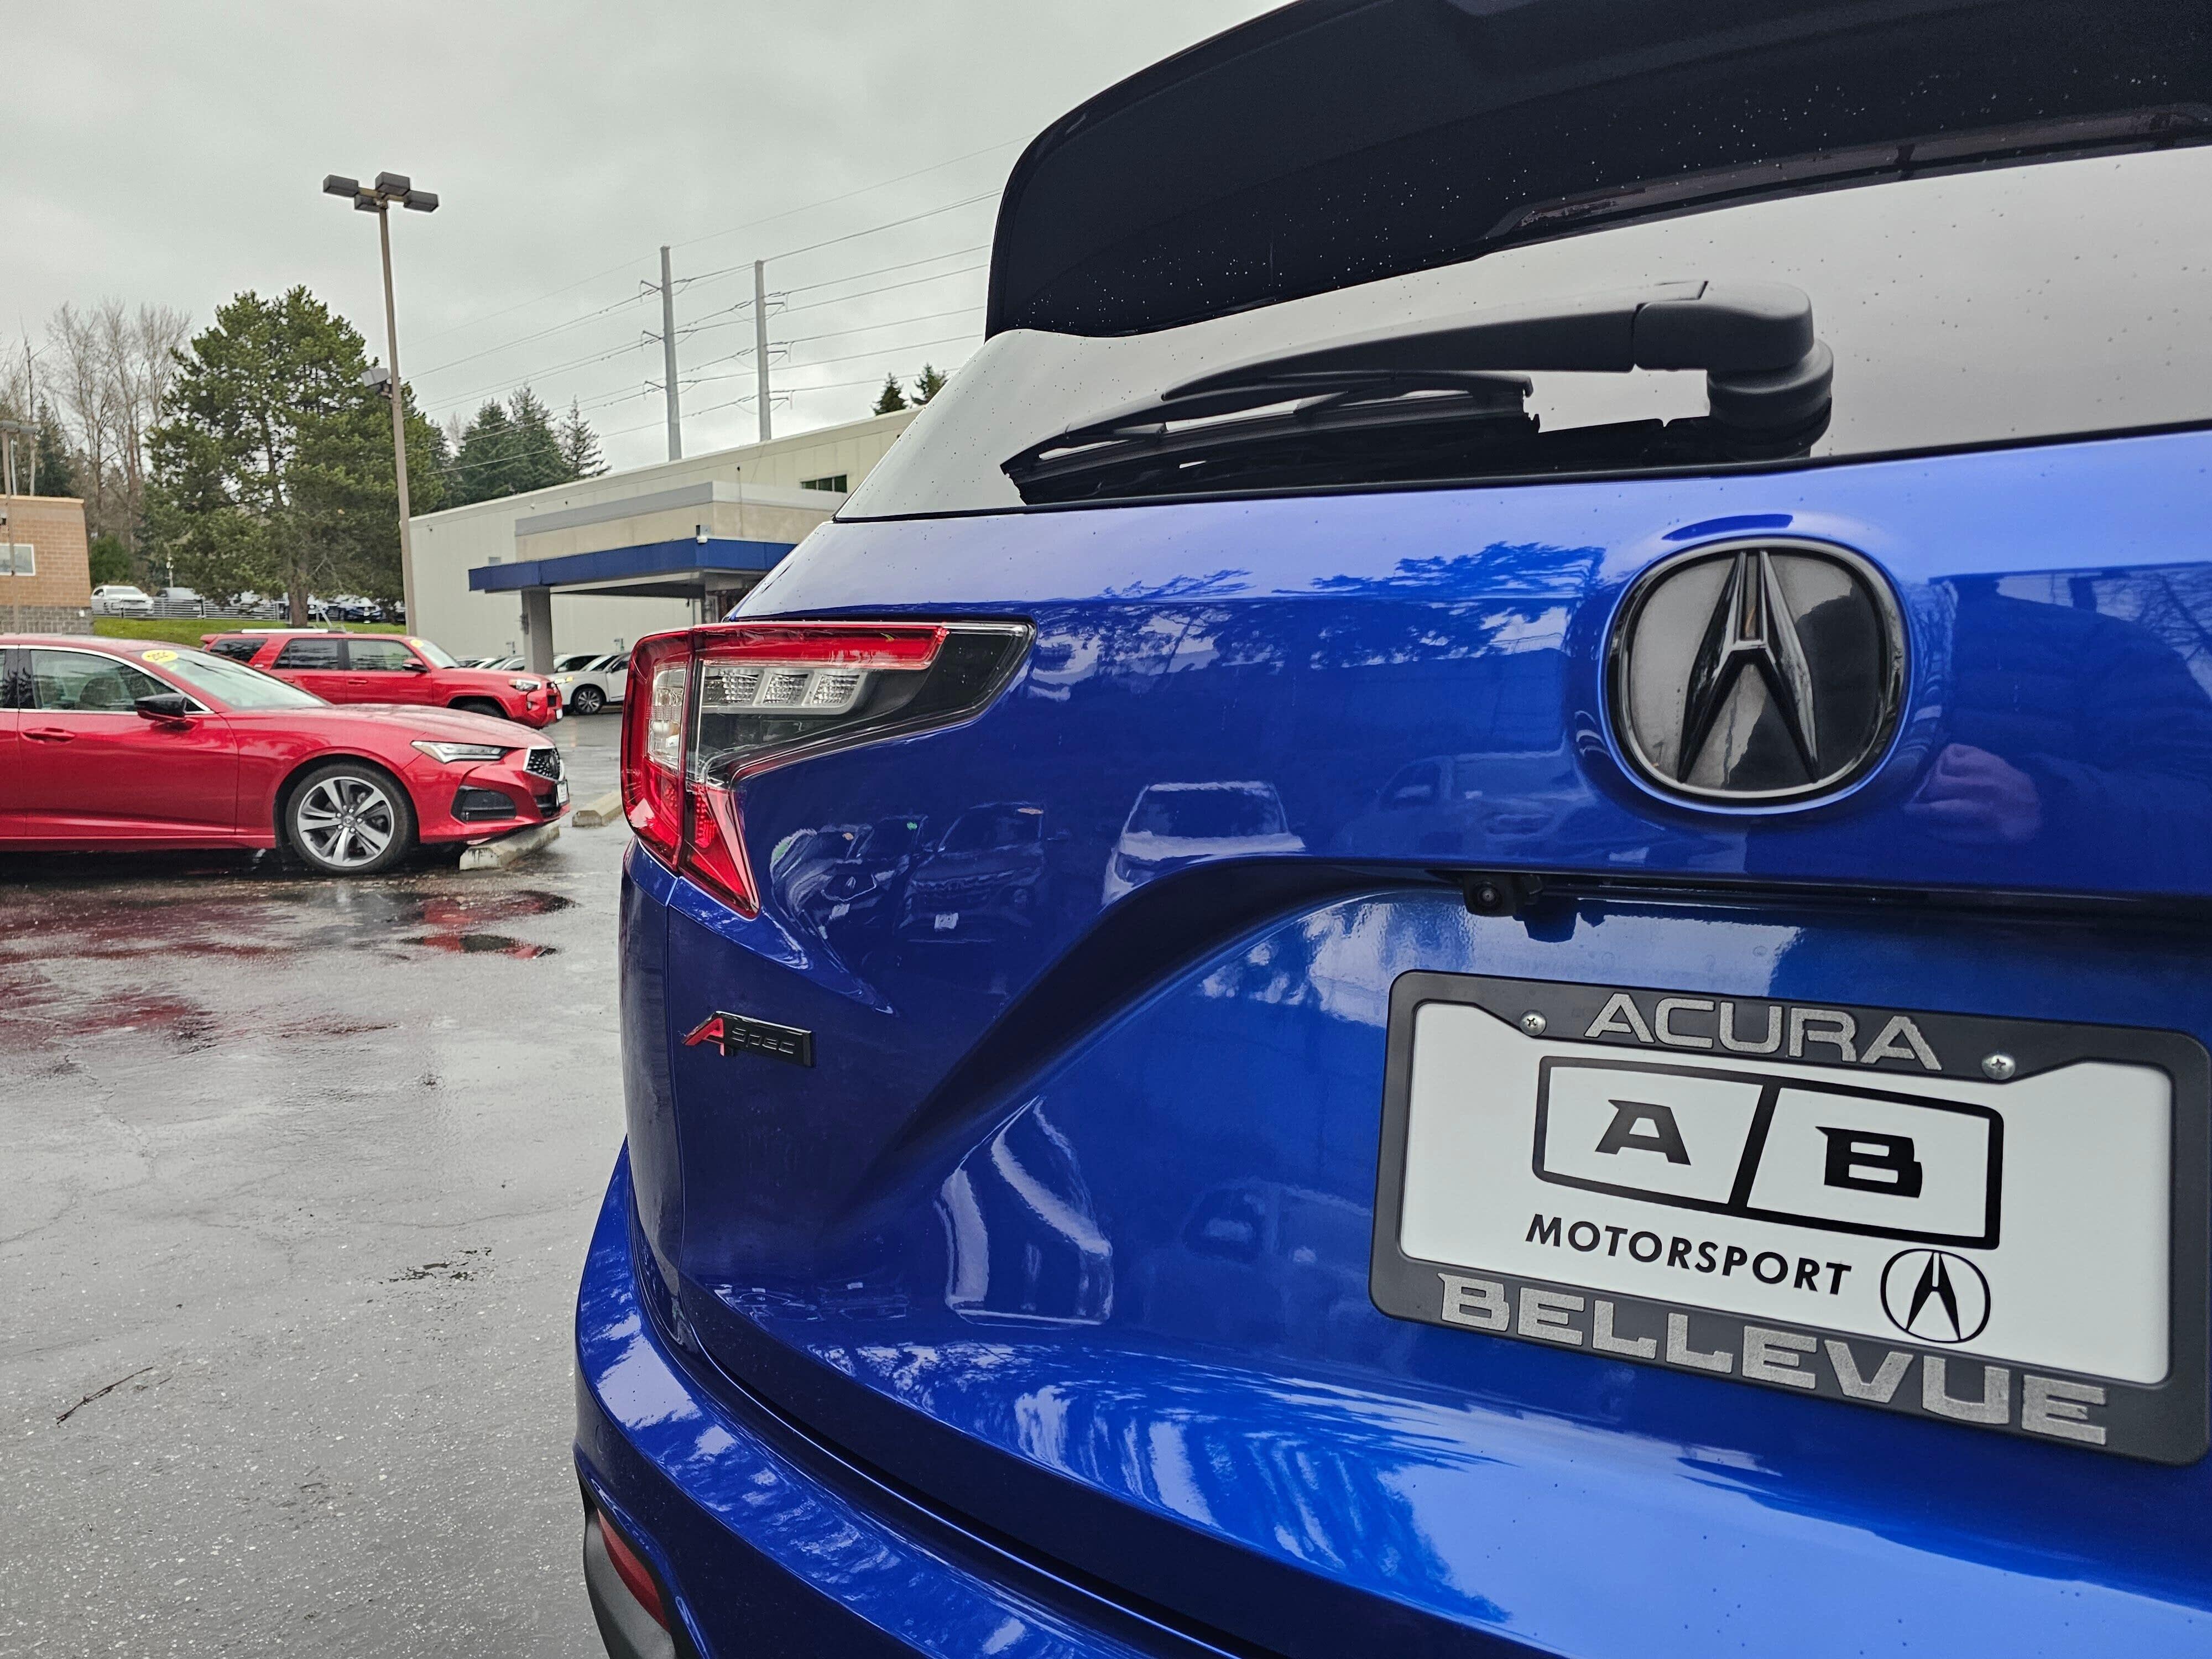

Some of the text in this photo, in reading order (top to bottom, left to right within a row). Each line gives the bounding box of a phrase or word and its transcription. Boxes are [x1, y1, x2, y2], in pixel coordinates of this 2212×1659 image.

[1585, 994, 1942, 1071] ACURA
[1595, 1100, 1922, 1198] A B
[1525, 1213, 1853, 1295] MOTORSPORT
[1438, 1273, 2106, 1445] BELLEVUE
